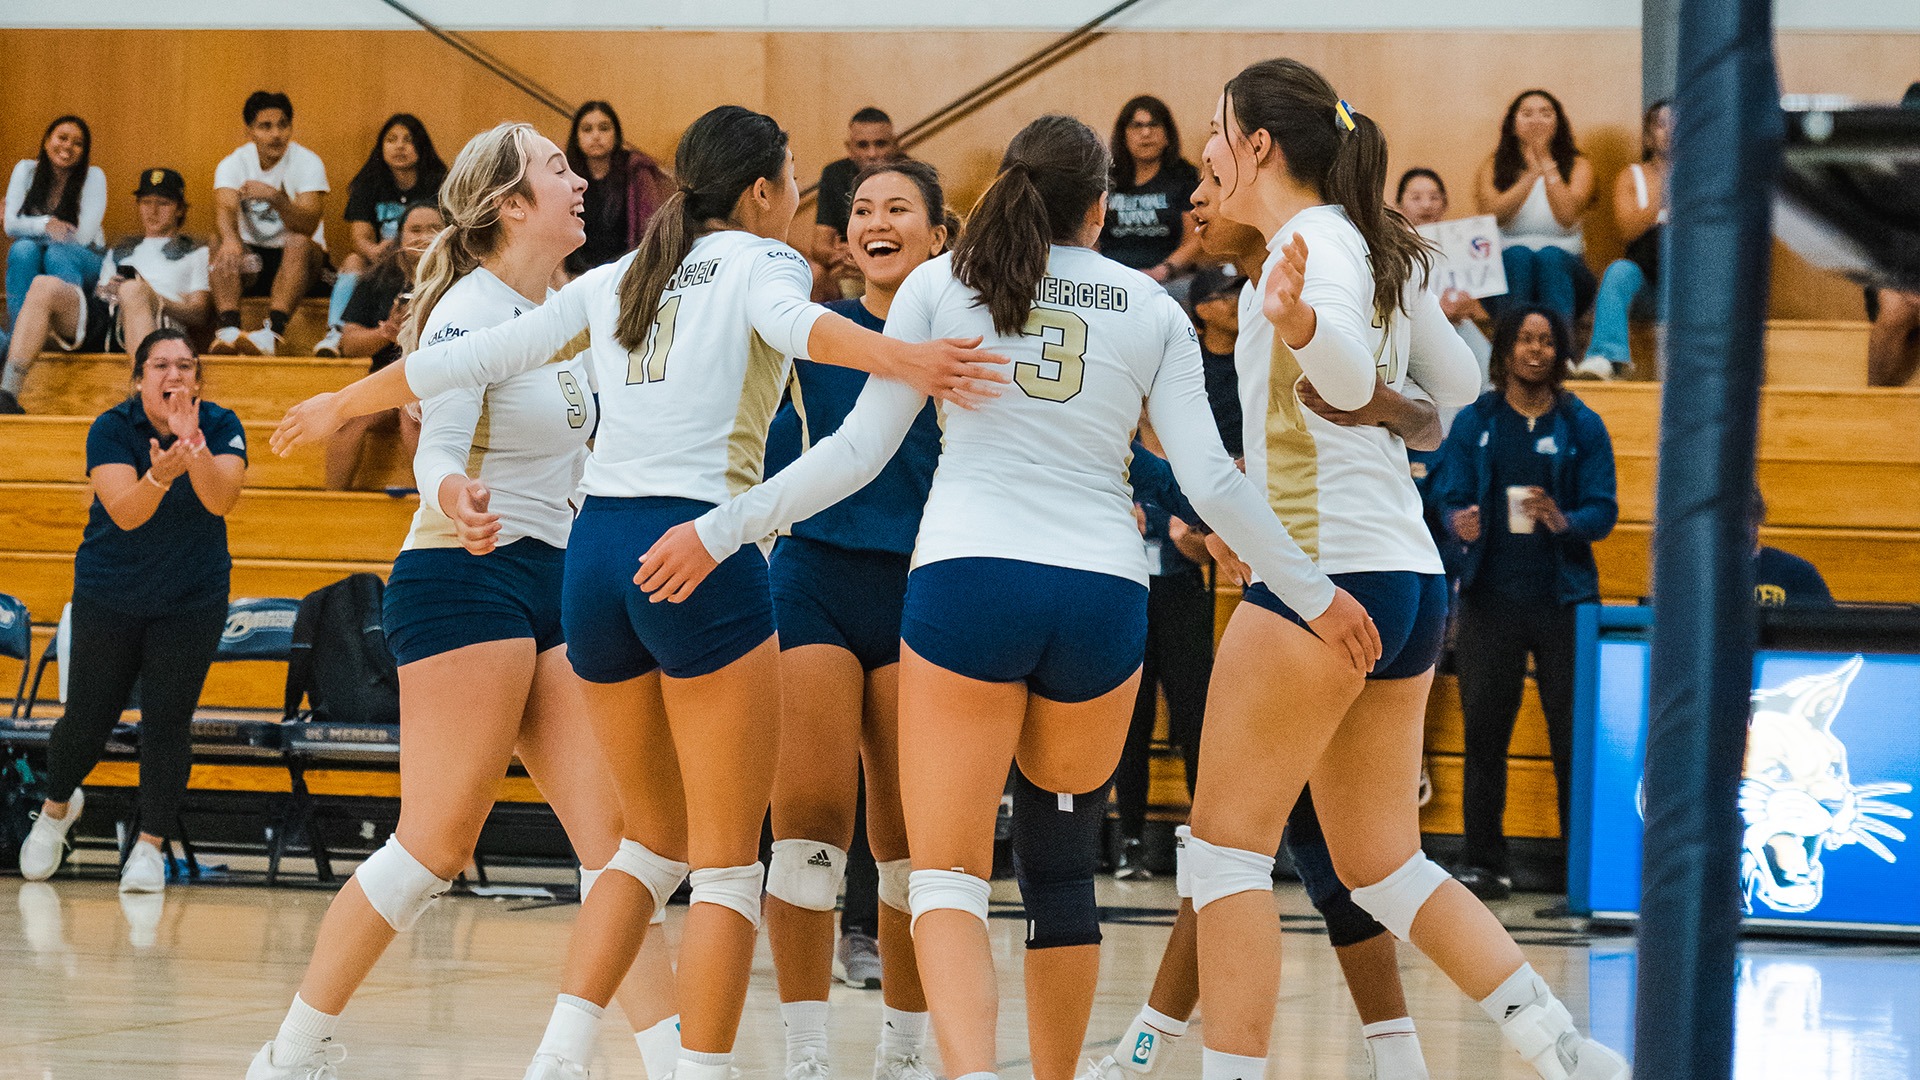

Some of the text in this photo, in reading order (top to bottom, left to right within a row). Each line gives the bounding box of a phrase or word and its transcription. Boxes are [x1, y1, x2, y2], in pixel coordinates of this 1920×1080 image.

[1036, 277, 1128, 312] ERCED
[1013, 307, 1089, 403] 3
[557, 371, 587, 428] 9
[807, 859, 832, 867] adidas
